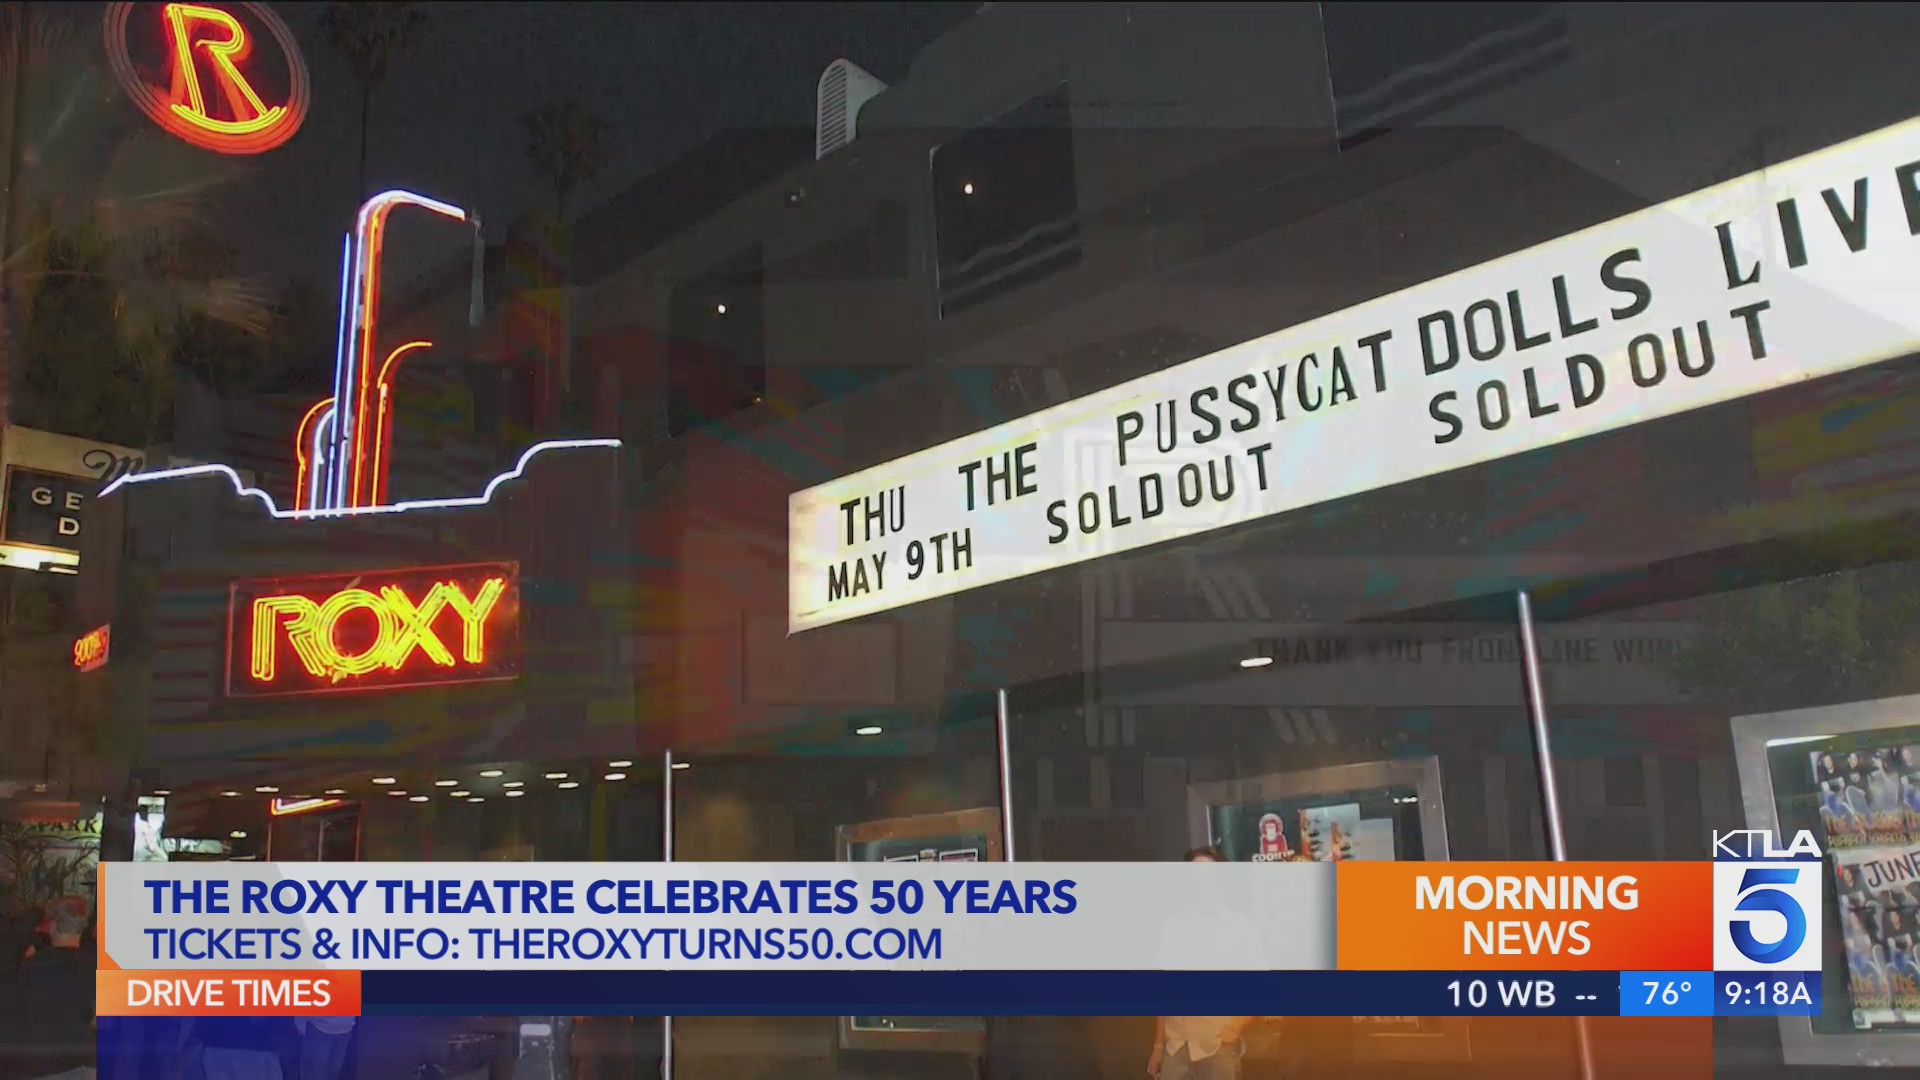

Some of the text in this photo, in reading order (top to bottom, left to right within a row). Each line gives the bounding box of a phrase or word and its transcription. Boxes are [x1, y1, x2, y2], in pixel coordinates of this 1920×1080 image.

[165, 3, 289, 135] R
[840, 485, 906, 546] THU
[958, 442, 1039, 512] THE
[1116, 329, 1393, 467] PUSSYCAT
[1417, 248, 1653, 376] DOLLS
[828, 551, 888, 602] MAY
[906, 527, 973, 580] 9TH
[251, 577, 505, 682] ROXY
